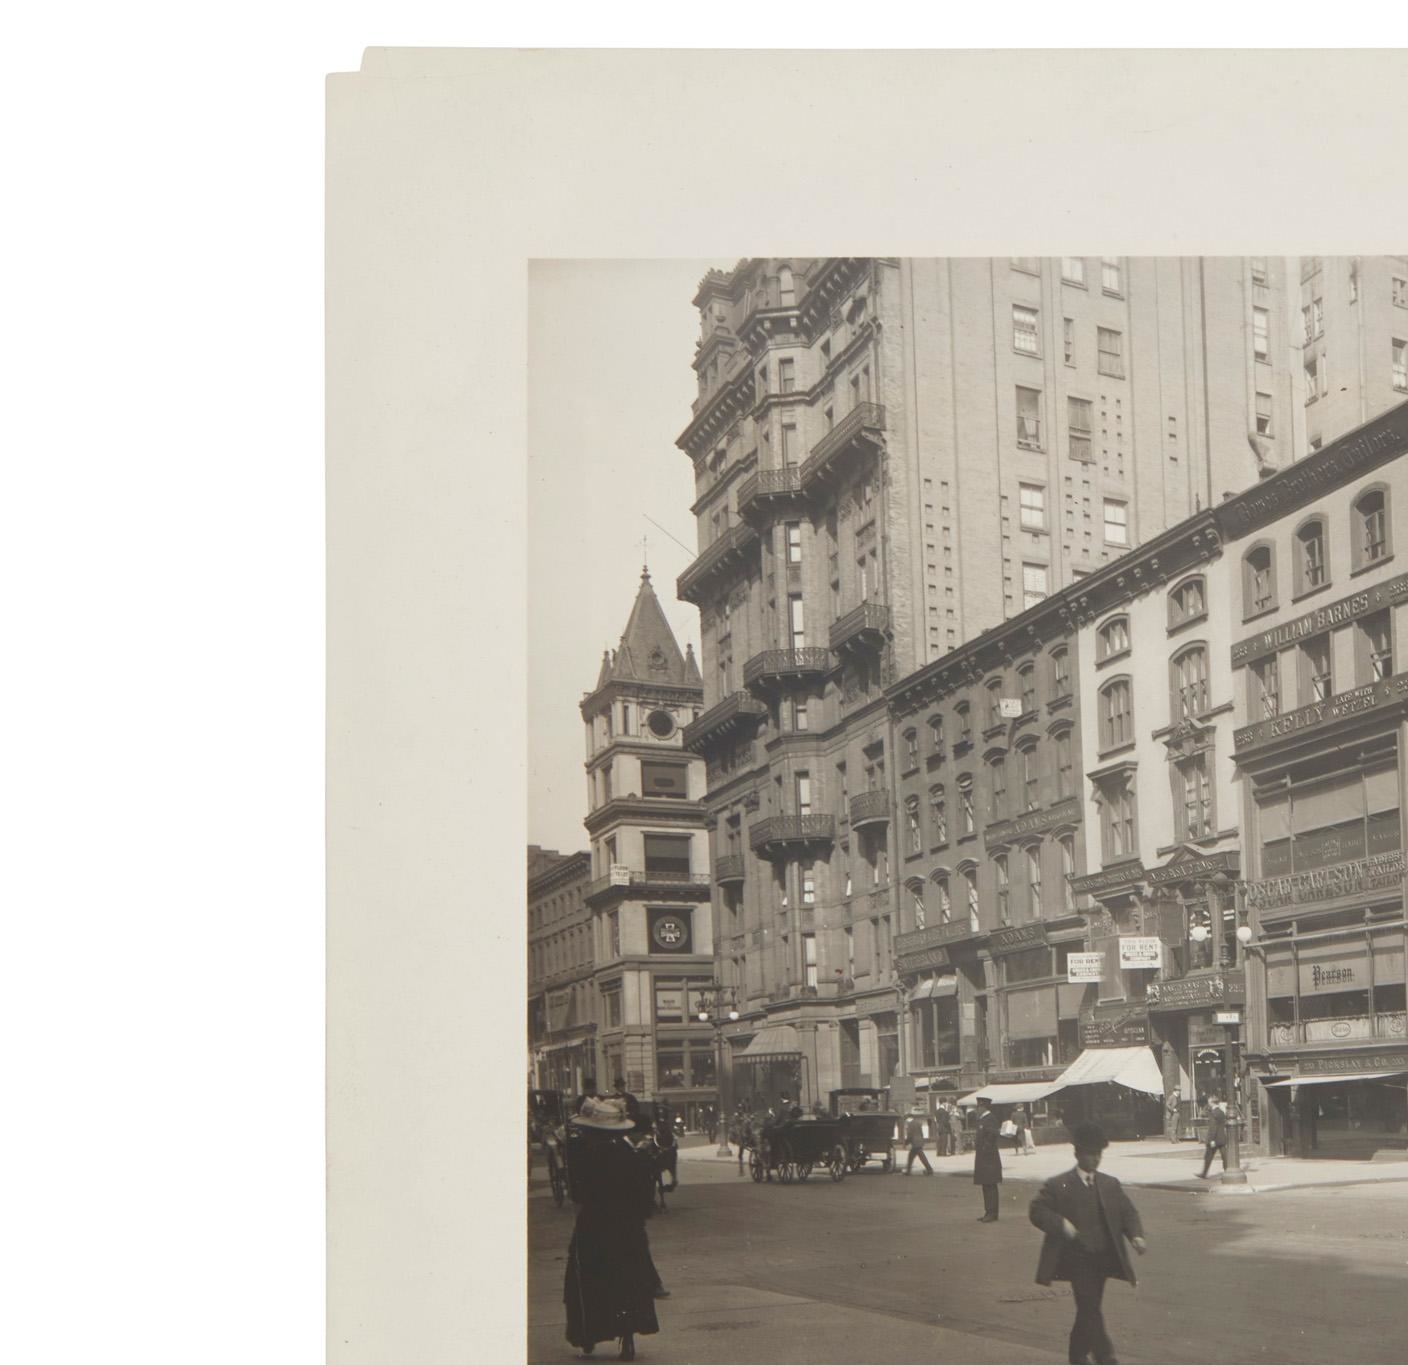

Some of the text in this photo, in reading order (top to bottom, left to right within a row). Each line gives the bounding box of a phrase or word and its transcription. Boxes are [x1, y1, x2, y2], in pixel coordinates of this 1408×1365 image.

[1263, 616, 1313, 649] WILLIAM
[1316, 593, 1369, 629] BARNES
[1270, 703, 1326, 738] KELLY
[1122, 943, 1158, 951] FOR RENT
